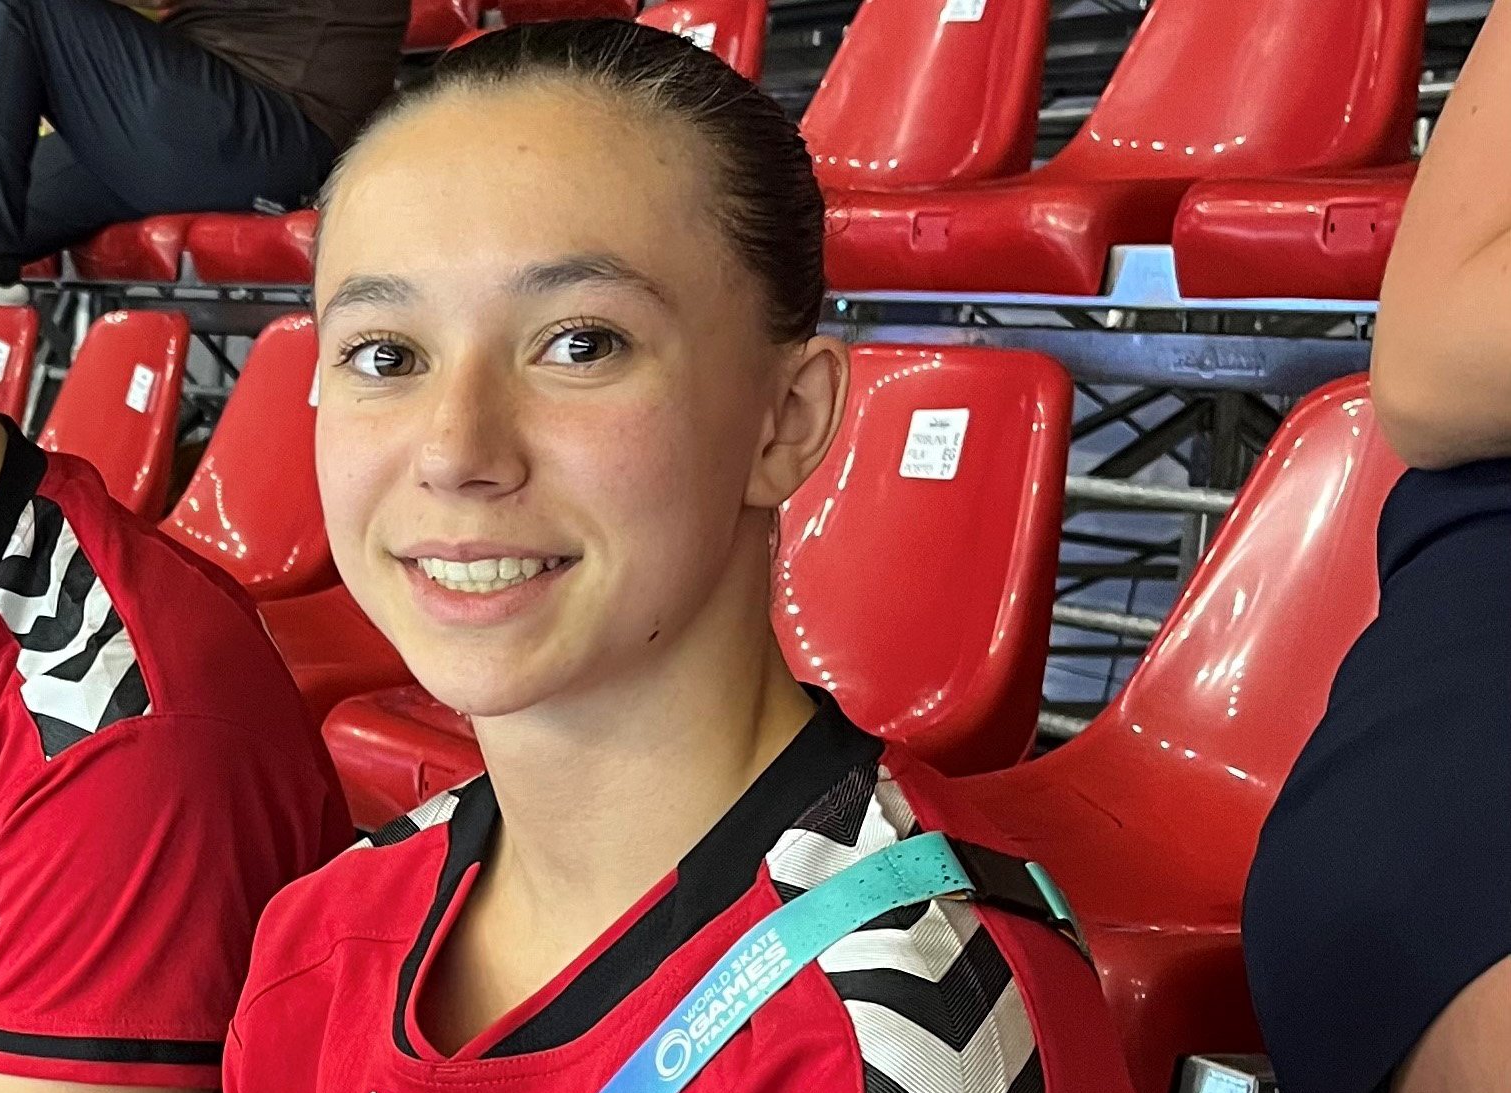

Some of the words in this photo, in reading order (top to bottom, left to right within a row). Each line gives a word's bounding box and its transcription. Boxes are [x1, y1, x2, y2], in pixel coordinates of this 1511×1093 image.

[681, 971, 731, 1024] WORLD
[729, 927, 780, 973] SKATE
[689, 940, 788, 1040] GAMES
[695, 1000, 748, 1053] ITALIA
[746, 958, 793, 1001] 2024
